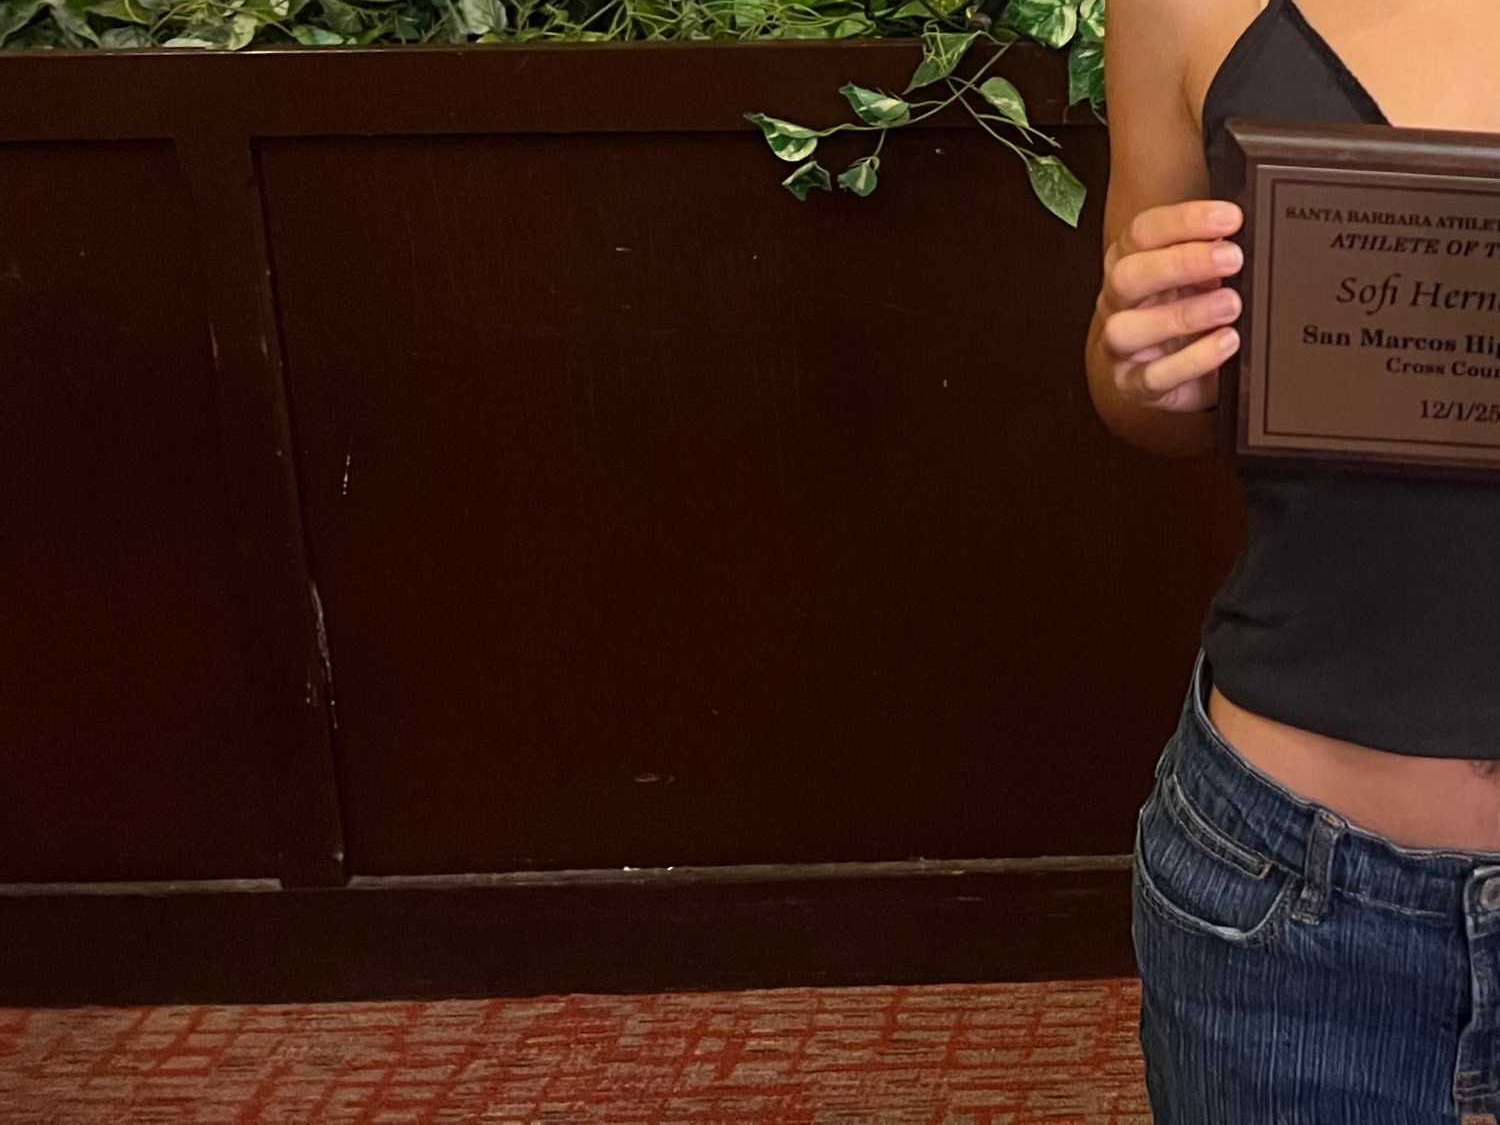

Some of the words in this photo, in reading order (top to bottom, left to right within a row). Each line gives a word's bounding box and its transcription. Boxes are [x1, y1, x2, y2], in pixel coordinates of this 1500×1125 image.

[1285, 206, 1344, 223] SANTA
[1348, 210, 1433, 227] BARBARA
[1329, 233, 1440, 255] ATHLETE
[1446, 239, 1479, 257] OF
[1336, 273, 1402, 316] Sofi
[1302, 325, 1351, 347] San
[1360, 328, 1457, 353] Marcos
[1386, 357, 1445, 375] Cross
